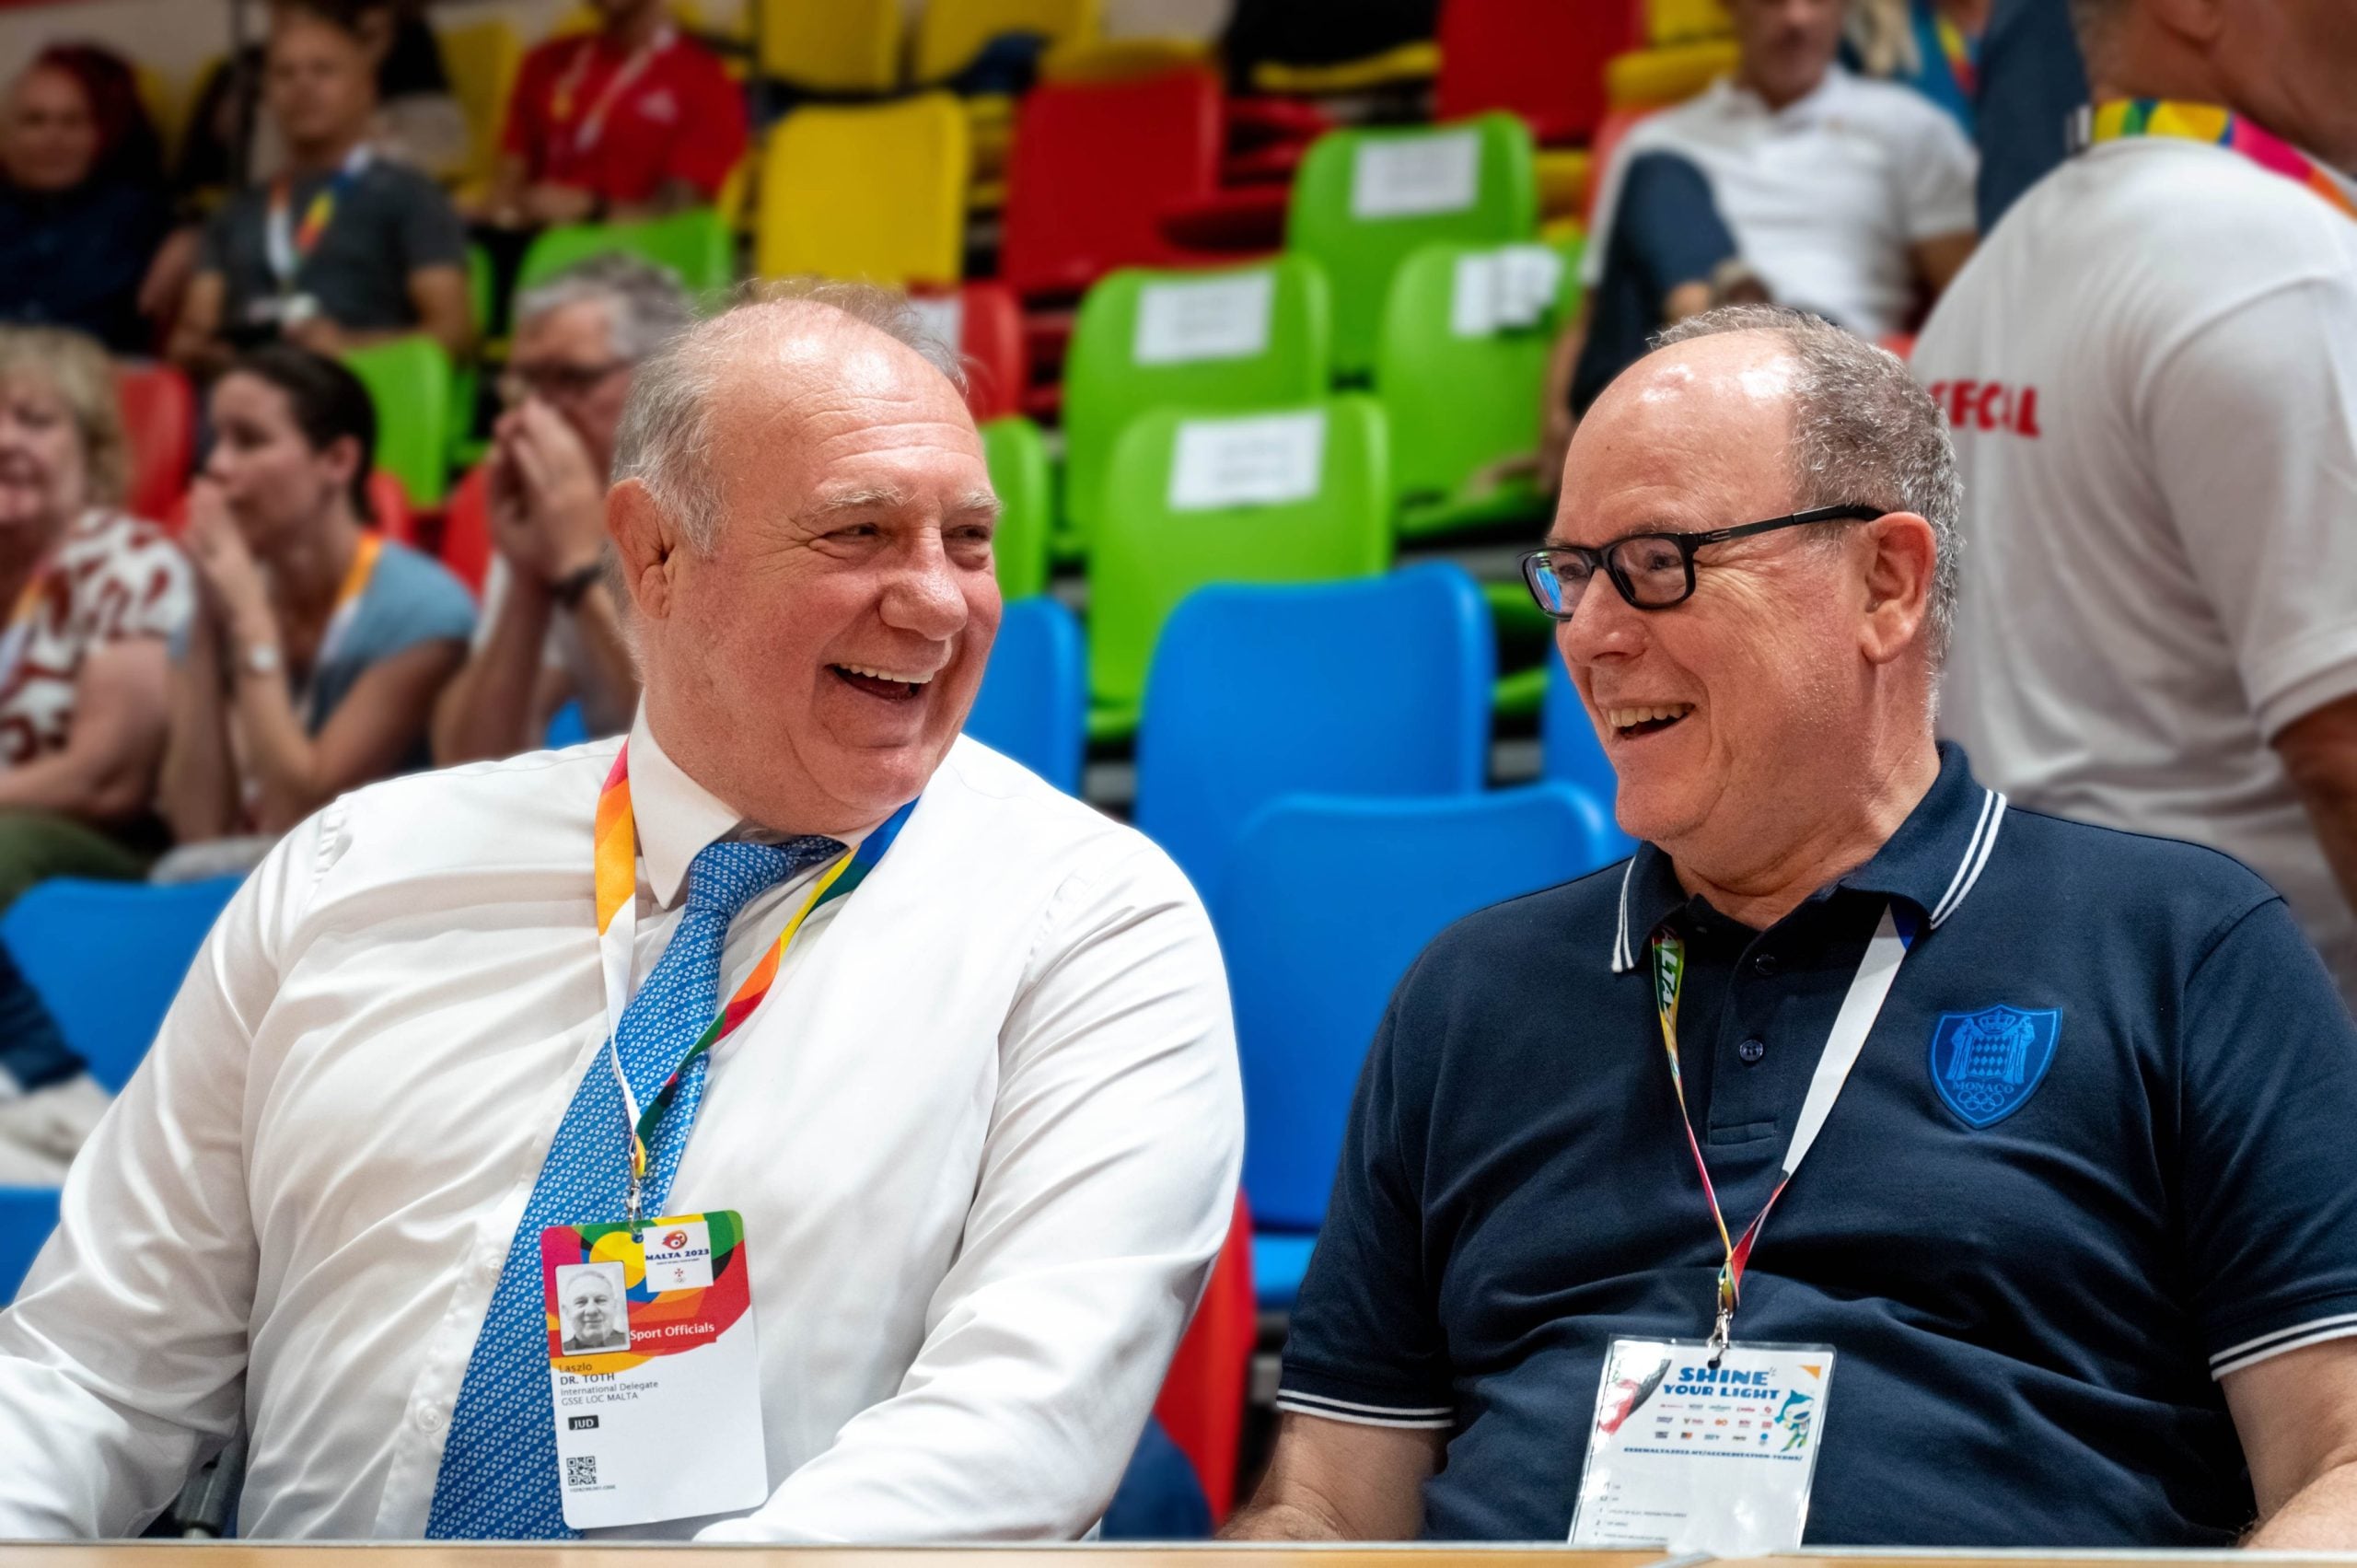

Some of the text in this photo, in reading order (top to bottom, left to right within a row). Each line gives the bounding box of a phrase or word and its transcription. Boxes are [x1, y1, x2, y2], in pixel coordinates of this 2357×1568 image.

[1953, 1080, 2014, 1094] MONACO
[645, 1249, 709, 1260] MALTA 2023
[630, 1322, 714, 1342] Sport Officials
[559, 1363, 592, 1373] Laszlo
[560, 1372, 615, 1386] DR. TOTH
[1678, 1366, 1770, 1386] SHINE
[561, 1381, 658, 1396] International Delegate
[1664, 1384, 1780, 1400] YOUR LIGHT
[586, 1395, 604, 1404] LOC
[608, 1391, 639, 1401] MALTA
[573, 1418, 595, 1430] JUD
